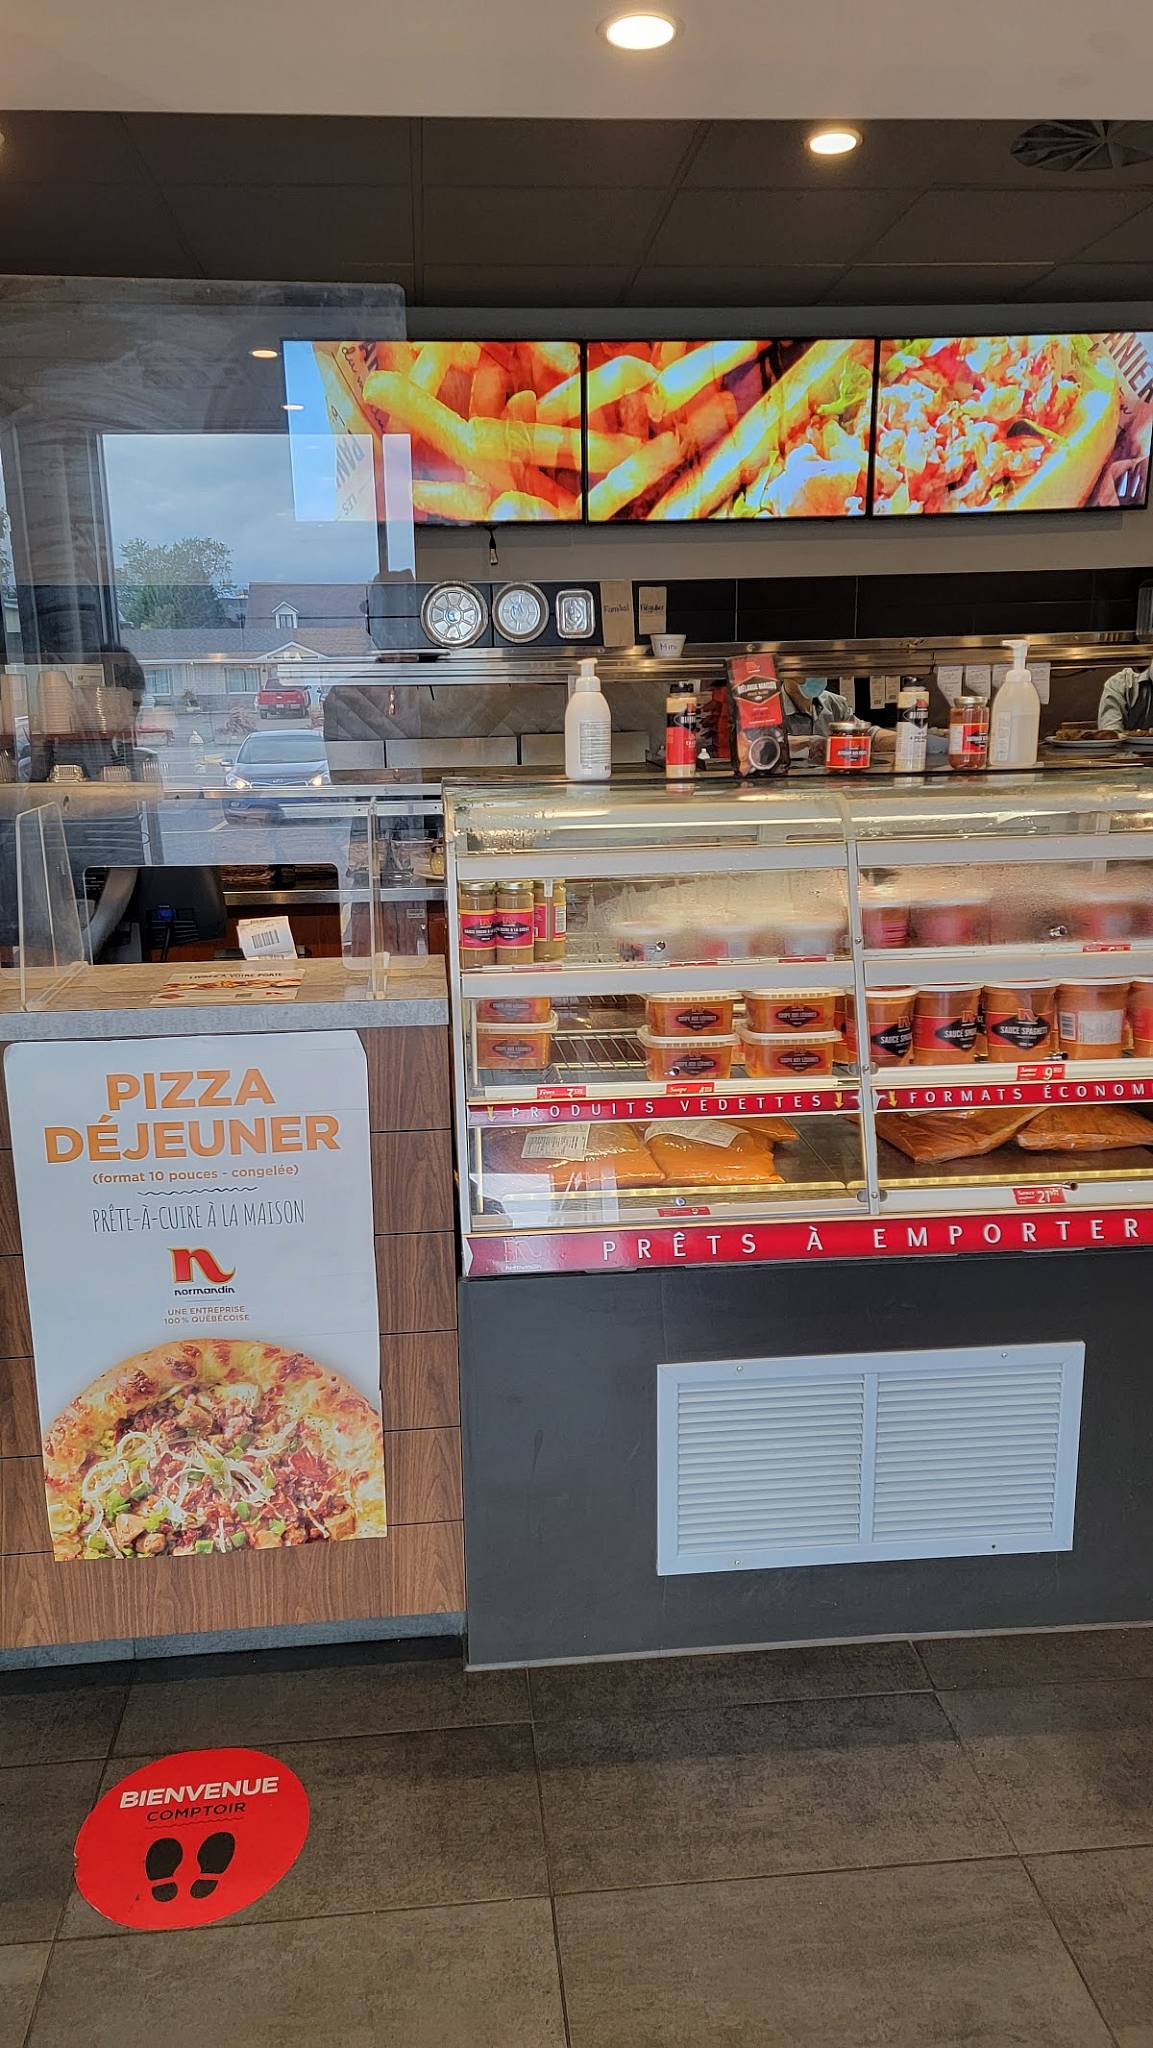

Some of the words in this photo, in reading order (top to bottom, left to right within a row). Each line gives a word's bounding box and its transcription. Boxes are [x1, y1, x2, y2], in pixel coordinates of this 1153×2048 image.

[880, 1036, 900, 1044] SAUCE
[944, 1030, 963, 1038] SAUCE
[1000, 1026, 1020, 1035] SAUCE
[106, 1068, 276, 1111] PIZZA
[910, 1088, 1022, 1104] FORMATS
[1044, 1083, 1153, 1099] ÉCONOM
[512, 1102, 654, 1119] PRODUITS
[680, 1095, 821, 1114] VEDETTES
[44, 1114, 341, 1163] DÉJEUNER
[92, 1171, 145, 1184] (format
[149, 1171, 164, 1181] 10
[169, 1169, 218, 1183] pouces
[231, 1165, 299, 1179] congelée)
[92, 1203, 202, 1232] PRÊTE-À-CUIRE
[207, 1201, 217, 1228] À
[221, 1203, 238, 1227] LA
[244, 1199, 305, 1226] MAISON
[603, 1233, 756, 1261] PRÊTS
[807, 1226, 823, 1251] À
[873, 1218, 1139, 1248] EMPORTER
[174, 1285, 236, 1296] normandin
[167, 1308, 188, 1316] UNE
[190, 1305, 246, 1315] ENTREPRISE
[119, 1776, 279, 1808] BIENVENUE
[146, 1802, 246, 1822] COMPTOIR
